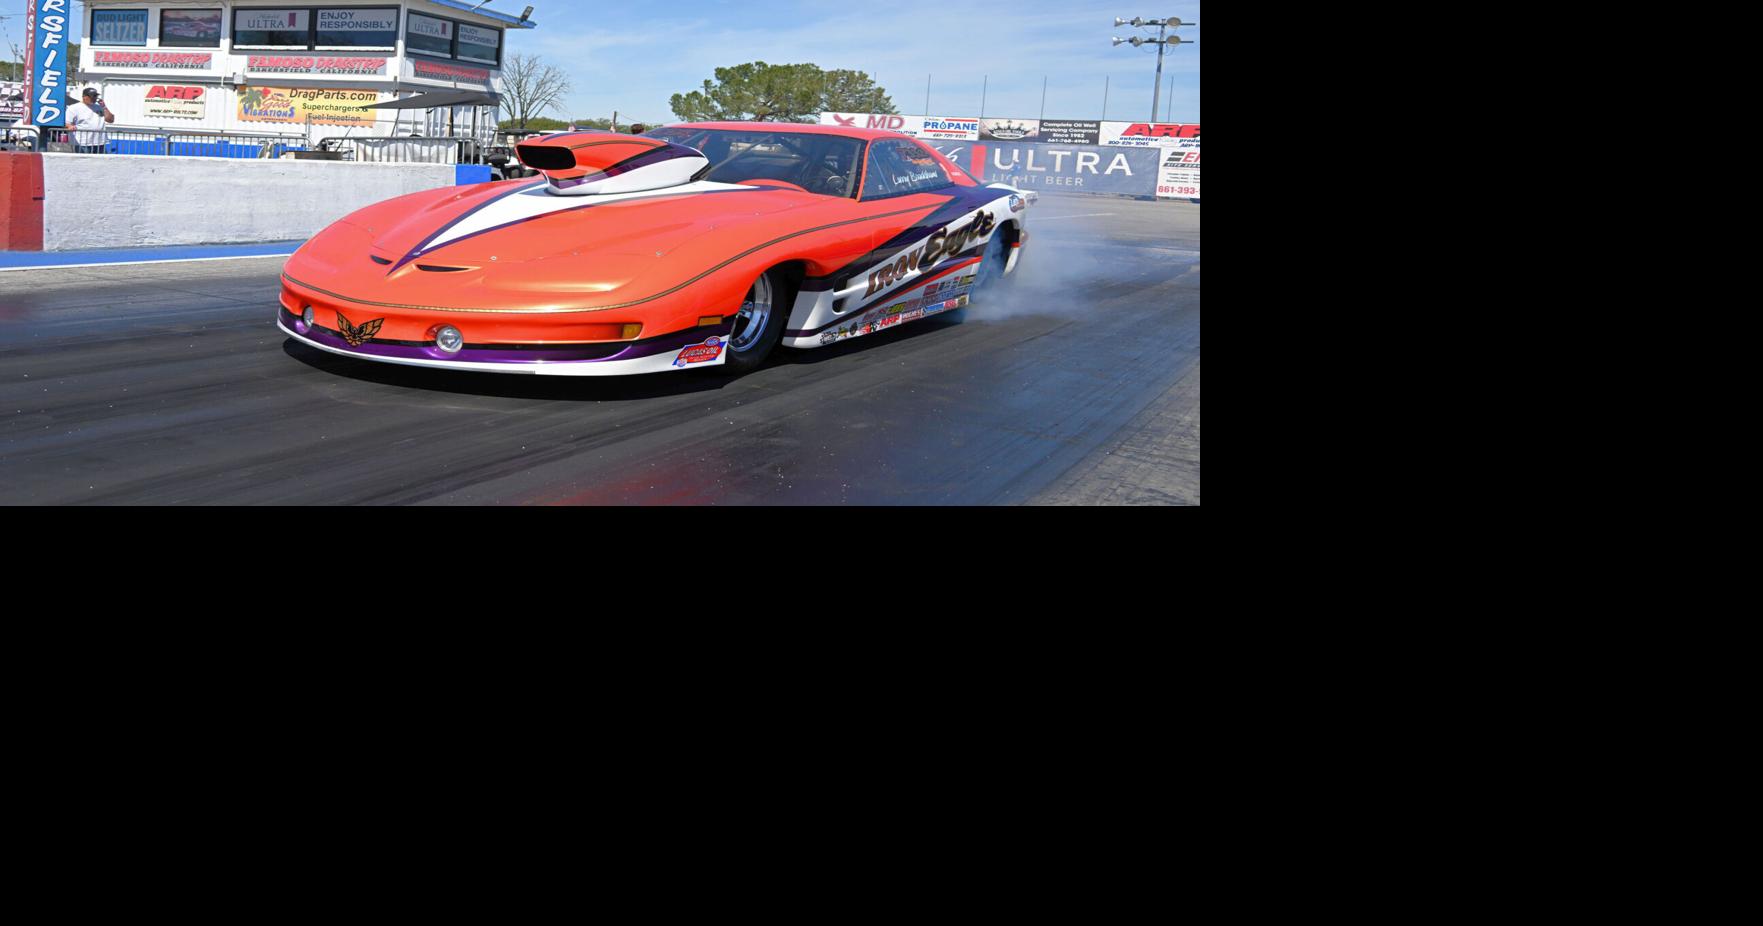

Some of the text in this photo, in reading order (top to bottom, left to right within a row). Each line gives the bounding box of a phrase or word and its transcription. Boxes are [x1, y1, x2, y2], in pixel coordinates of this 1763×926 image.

[117, 13, 145, 22] LIGHT
[320, 11, 355, 20] ENJOY
[247, 19, 285, 29] ULTRA
[320, 20, 393, 29] RESPONSIBLY
[414, 23, 440, 35] ULTRA
[96, 22, 145, 42] SELTZER
[460, 26, 478, 35] ENJOY
[95, 51, 151, 63] FAMOSO
[249, 56, 314, 68] FAMOSO
[145, 85, 204, 100] ARP
[289, 88, 377, 102] DragParts.com
[242, 104, 295, 118] VIBRATIONS
[302, 102, 360, 113] Superchargers
[865, 115, 905, 130] MD
[923, 120, 978, 132] PROPANE
[993, 147, 1134, 176] ULTRA
[1045, 175, 1084, 187] BEER
[1158, 185, 1200, 195] 661-393-
[917, 208, 996, 274] Eagle
[879, 314, 901, 328] ARP
